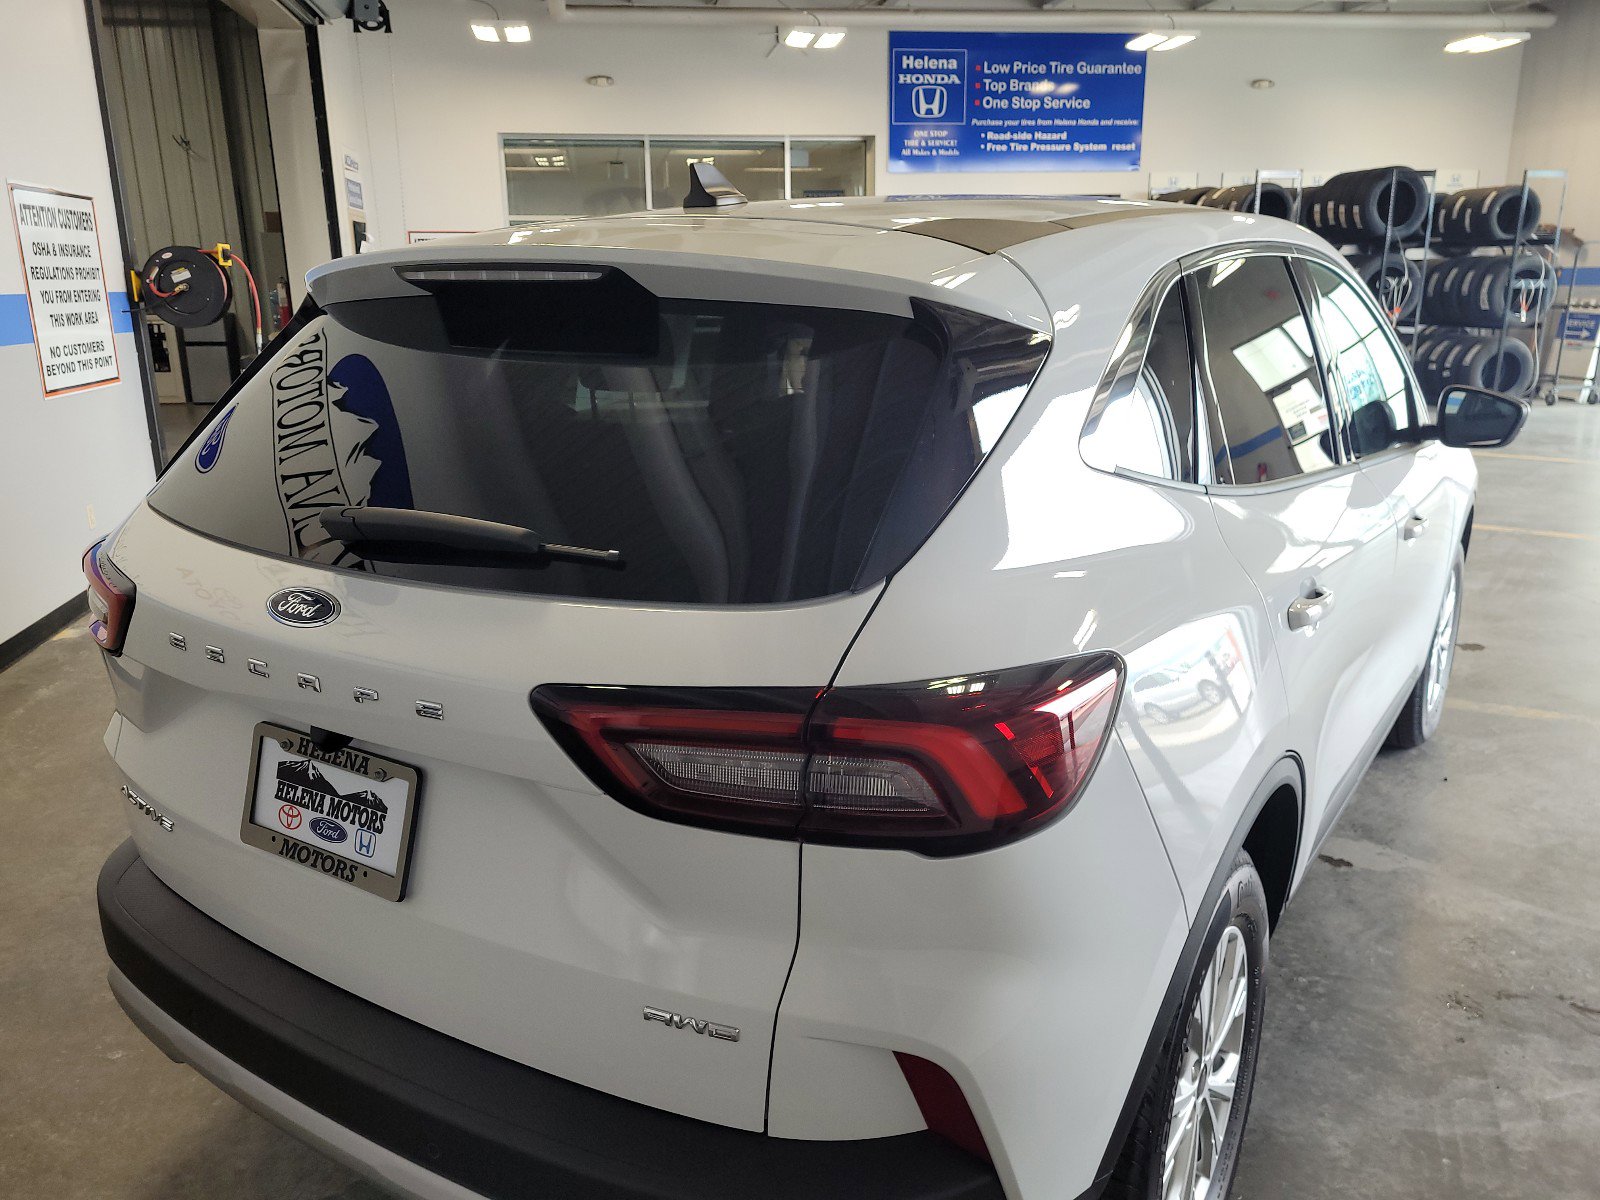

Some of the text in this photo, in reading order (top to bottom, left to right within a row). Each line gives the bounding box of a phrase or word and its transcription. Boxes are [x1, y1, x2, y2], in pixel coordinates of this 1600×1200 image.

[901, 55, 958, 70] Helena
[983, 61, 1143, 75] Low Price Tire Guarantee
[897, 73, 961, 85] HONDA
[983, 78, 1007, 94] Top
[982, 96, 1091, 111] One Stop Service
[971, 118, 1004, 126] Purchase
[1004, 119, 1020, 128] your
[1021, 118, 1035, 126] tires
[1036, 118, 1053, 126] from
[1077, 118, 1099, 126] Honda
[1100, 118, 1113, 126] and
[929, 130, 948, 138] STOP
[986, 131, 1067, 140] Road-side Hazard
[904, 139, 919, 147] TIRE
[986, 142, 1136, 153] Free Tire Pressure System reset
[19, 203, 94, 232] ATTENTION CUSTOMERS
[32, 241, 92, 258] OSHA & INSURANCE
[30, 266, 101, 281] REGULATIONS PROHIBIT
[40, 290, 101, 304] YOU FROM ENTERING
[50, 312, 99, 328] THIS WORK AREA
[50, 340, 105, 359] NO CUSTOMERS
[46, 355, 113, 377] BEYOND THIS POINT
[168, 631, 445, 721] ESCAPE
[274, 779, 387, 835] HELENA MOTORS
[278, 837, 358, 883] MOTORS
[643, 1005, 740, 1042] AWD
